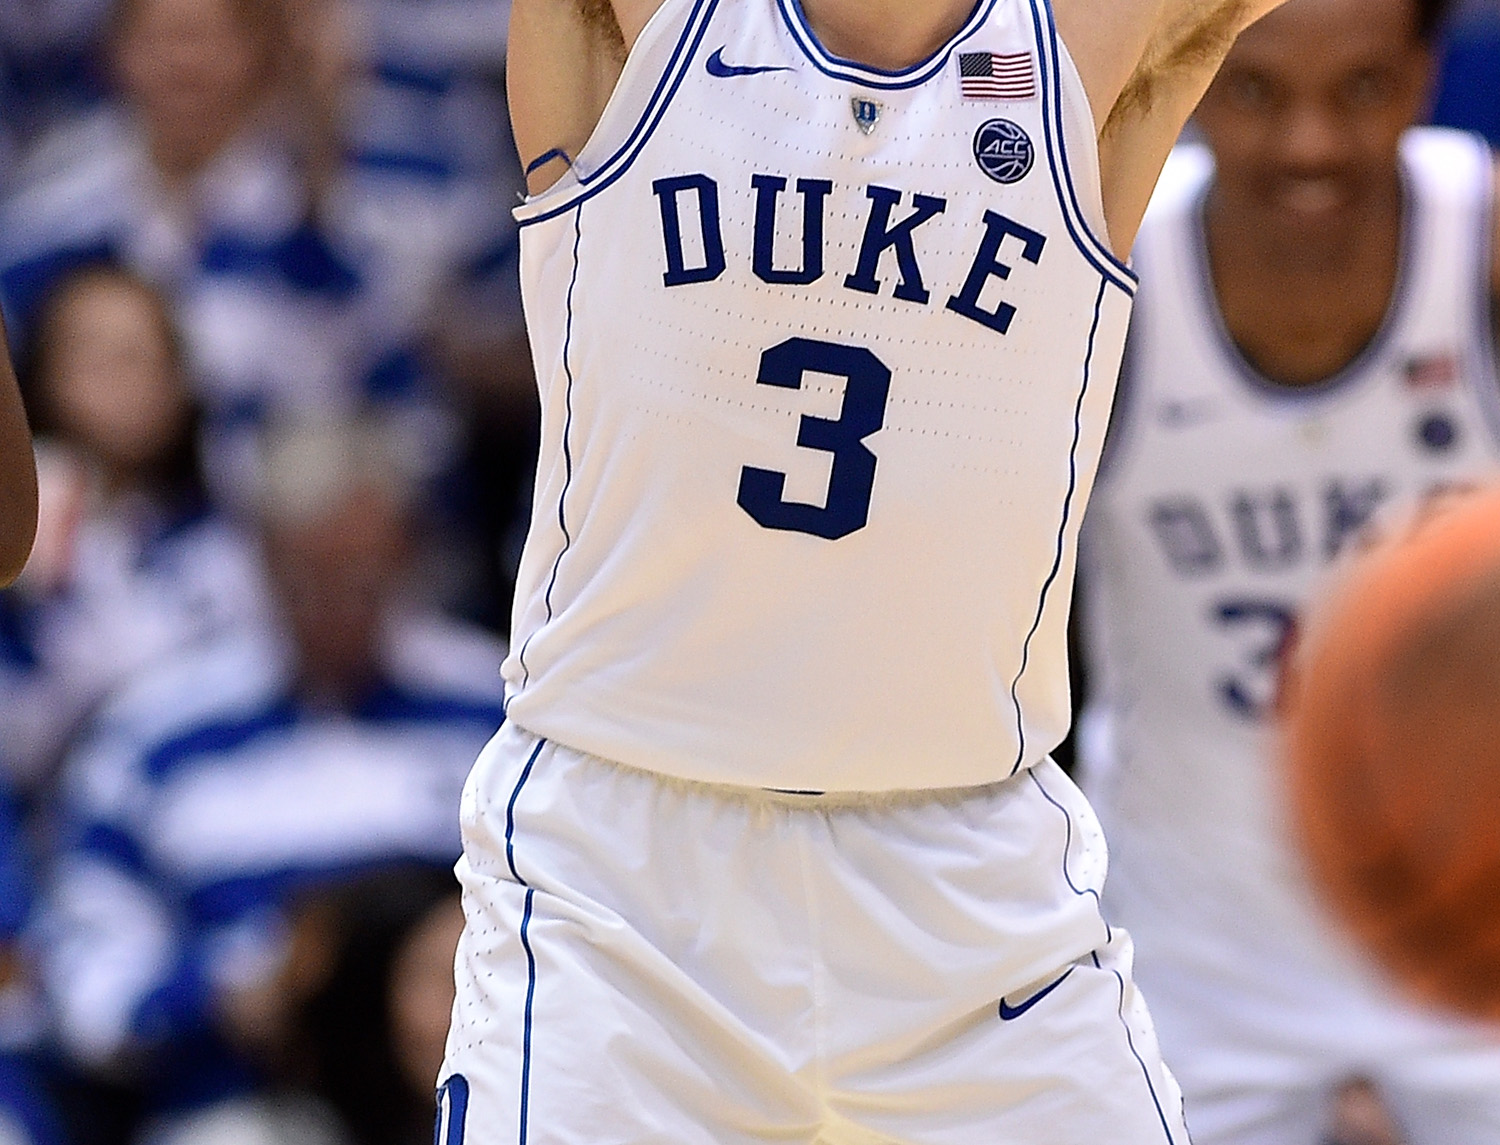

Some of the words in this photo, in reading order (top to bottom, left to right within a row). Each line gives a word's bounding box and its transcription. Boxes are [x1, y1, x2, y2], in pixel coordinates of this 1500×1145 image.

[984, 139, 1028, 154] ACC
[652, 172, 1047, 335] DUKE
[736, 336, 892, 541] 3
